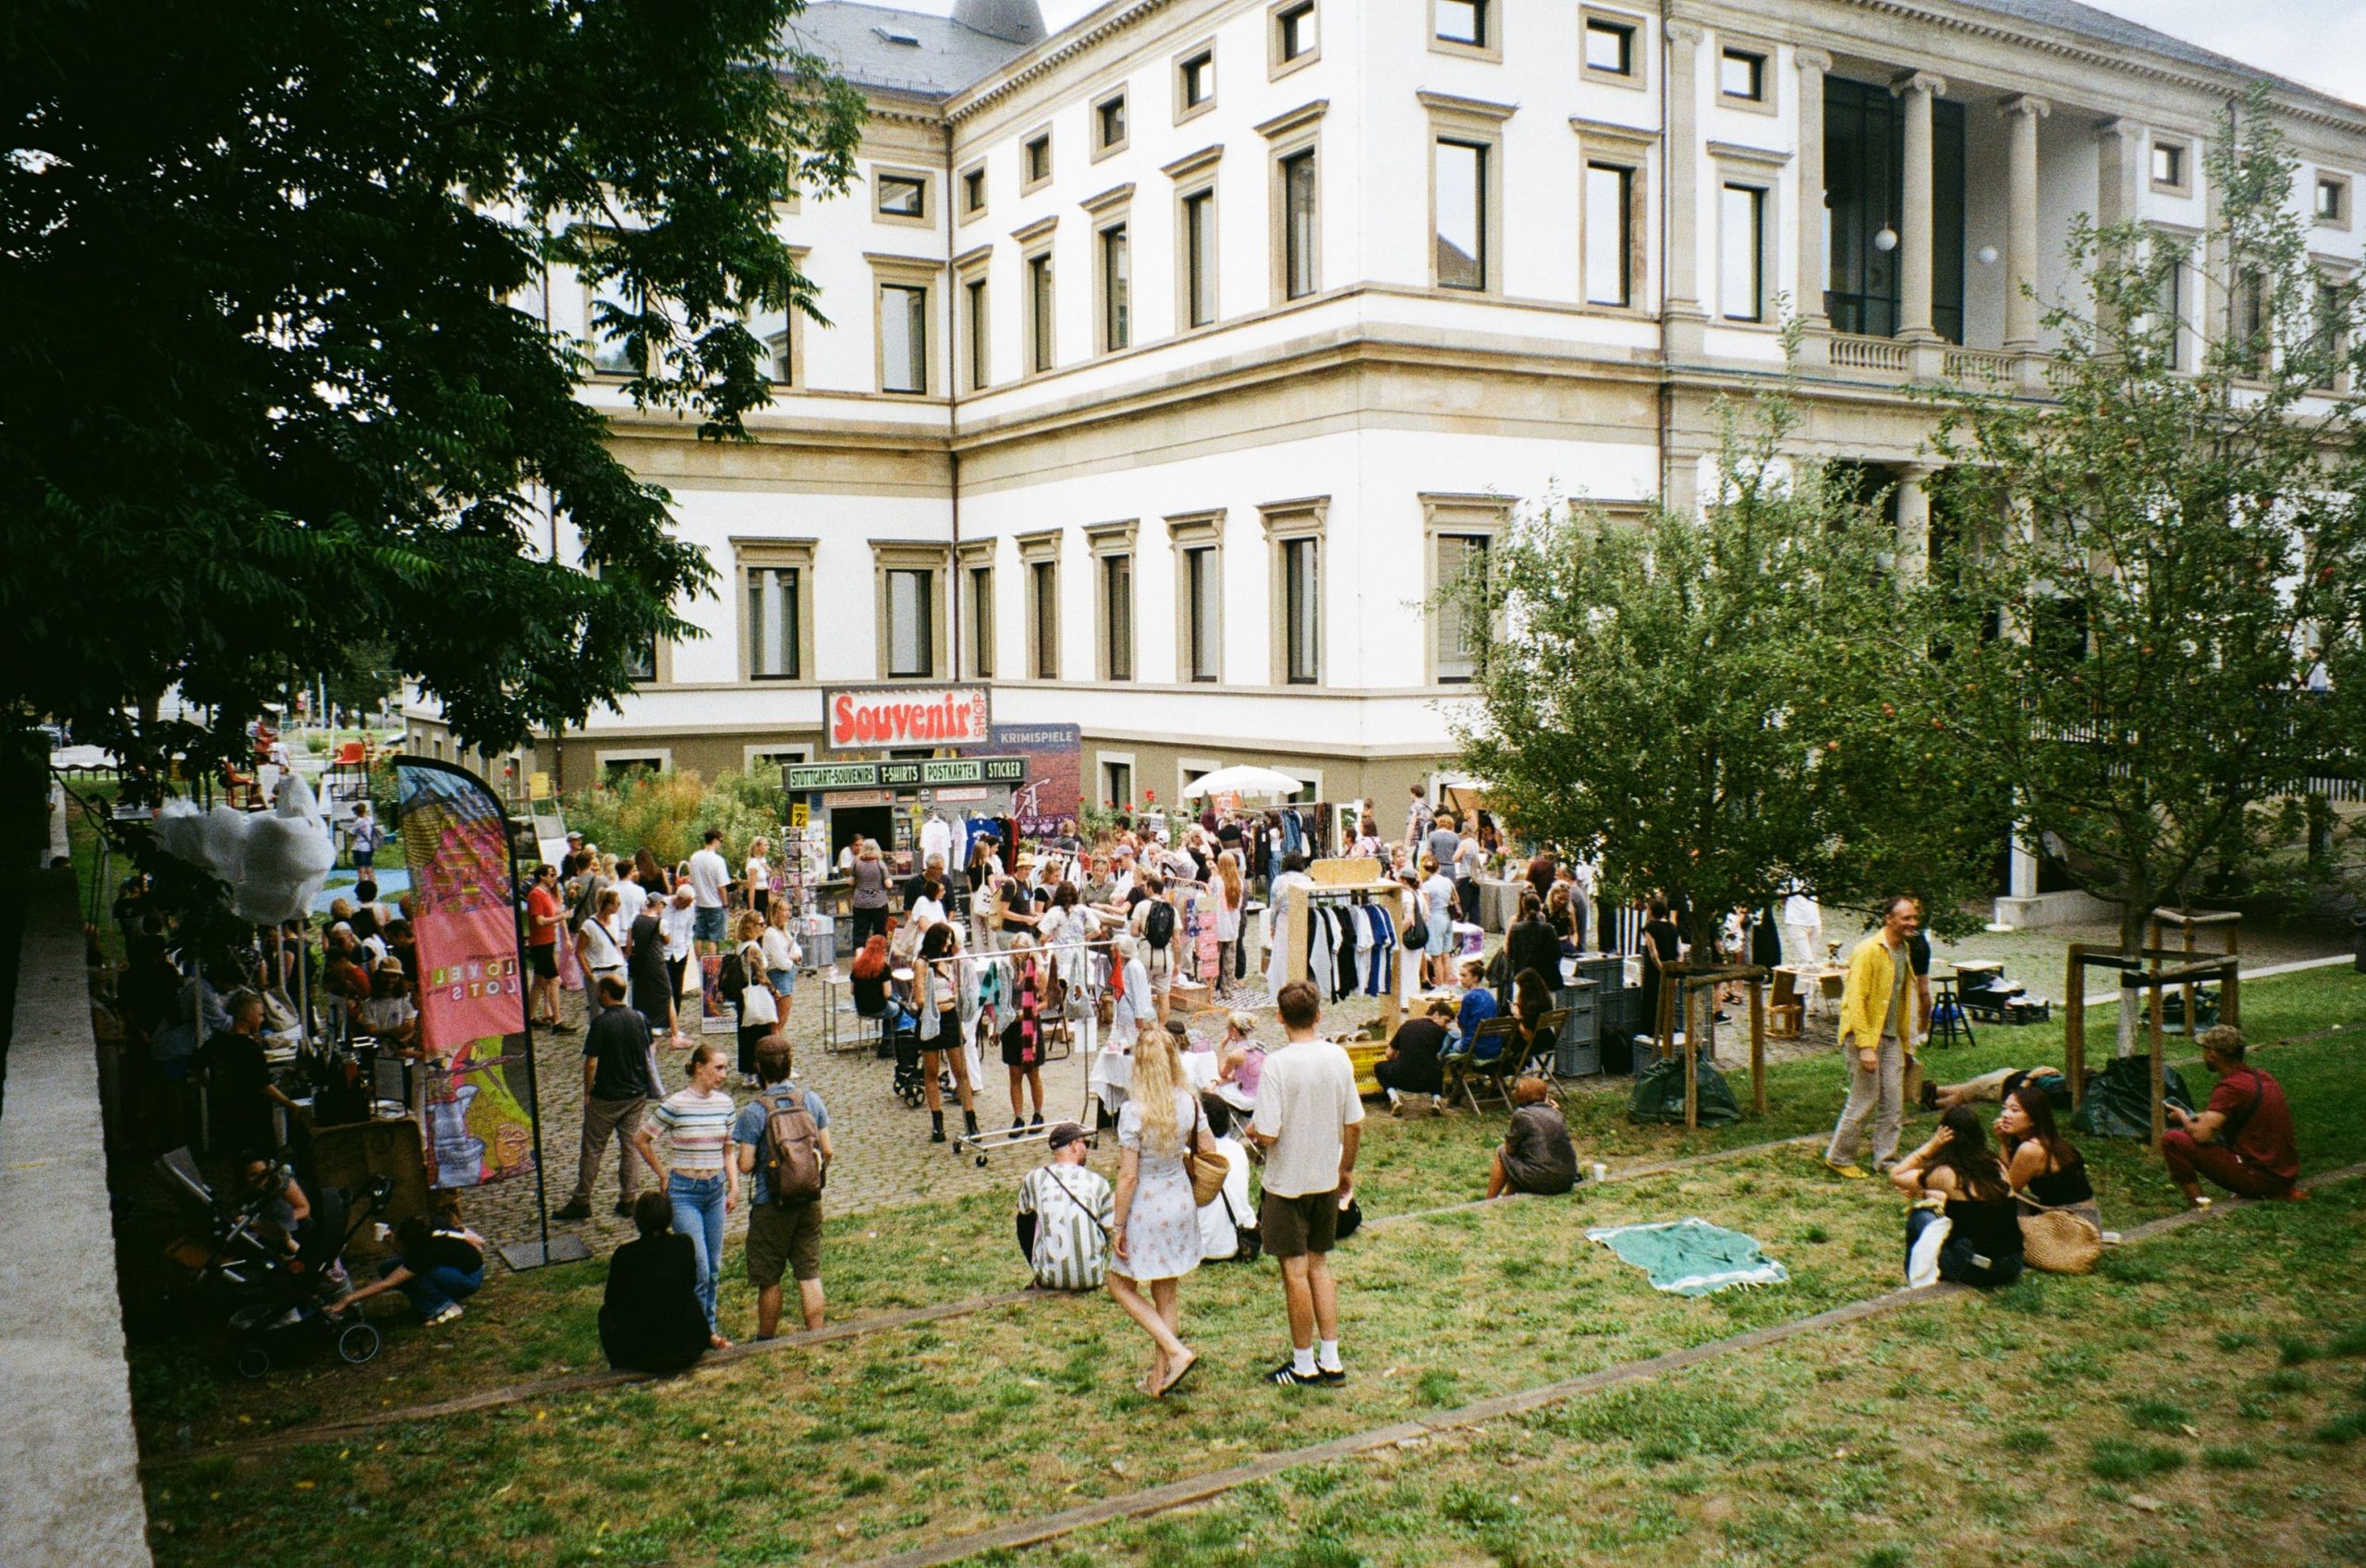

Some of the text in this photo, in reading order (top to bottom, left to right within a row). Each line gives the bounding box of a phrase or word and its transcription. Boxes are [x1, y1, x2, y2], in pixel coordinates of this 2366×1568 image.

[835, 693, 970, 743] Souvenir
[973, 693, 985, 737] SHOP
[1001, 731, 1073, 744] KRIMISPIELE
[791, 767, 874, 786] STUTTGART-SOUVENIRS
[881, 765, 919, 784] T-SHIRTS
[927, 762, 979, 781] POSTKARTEN
[987, 761, 1020, 779] STICKER
